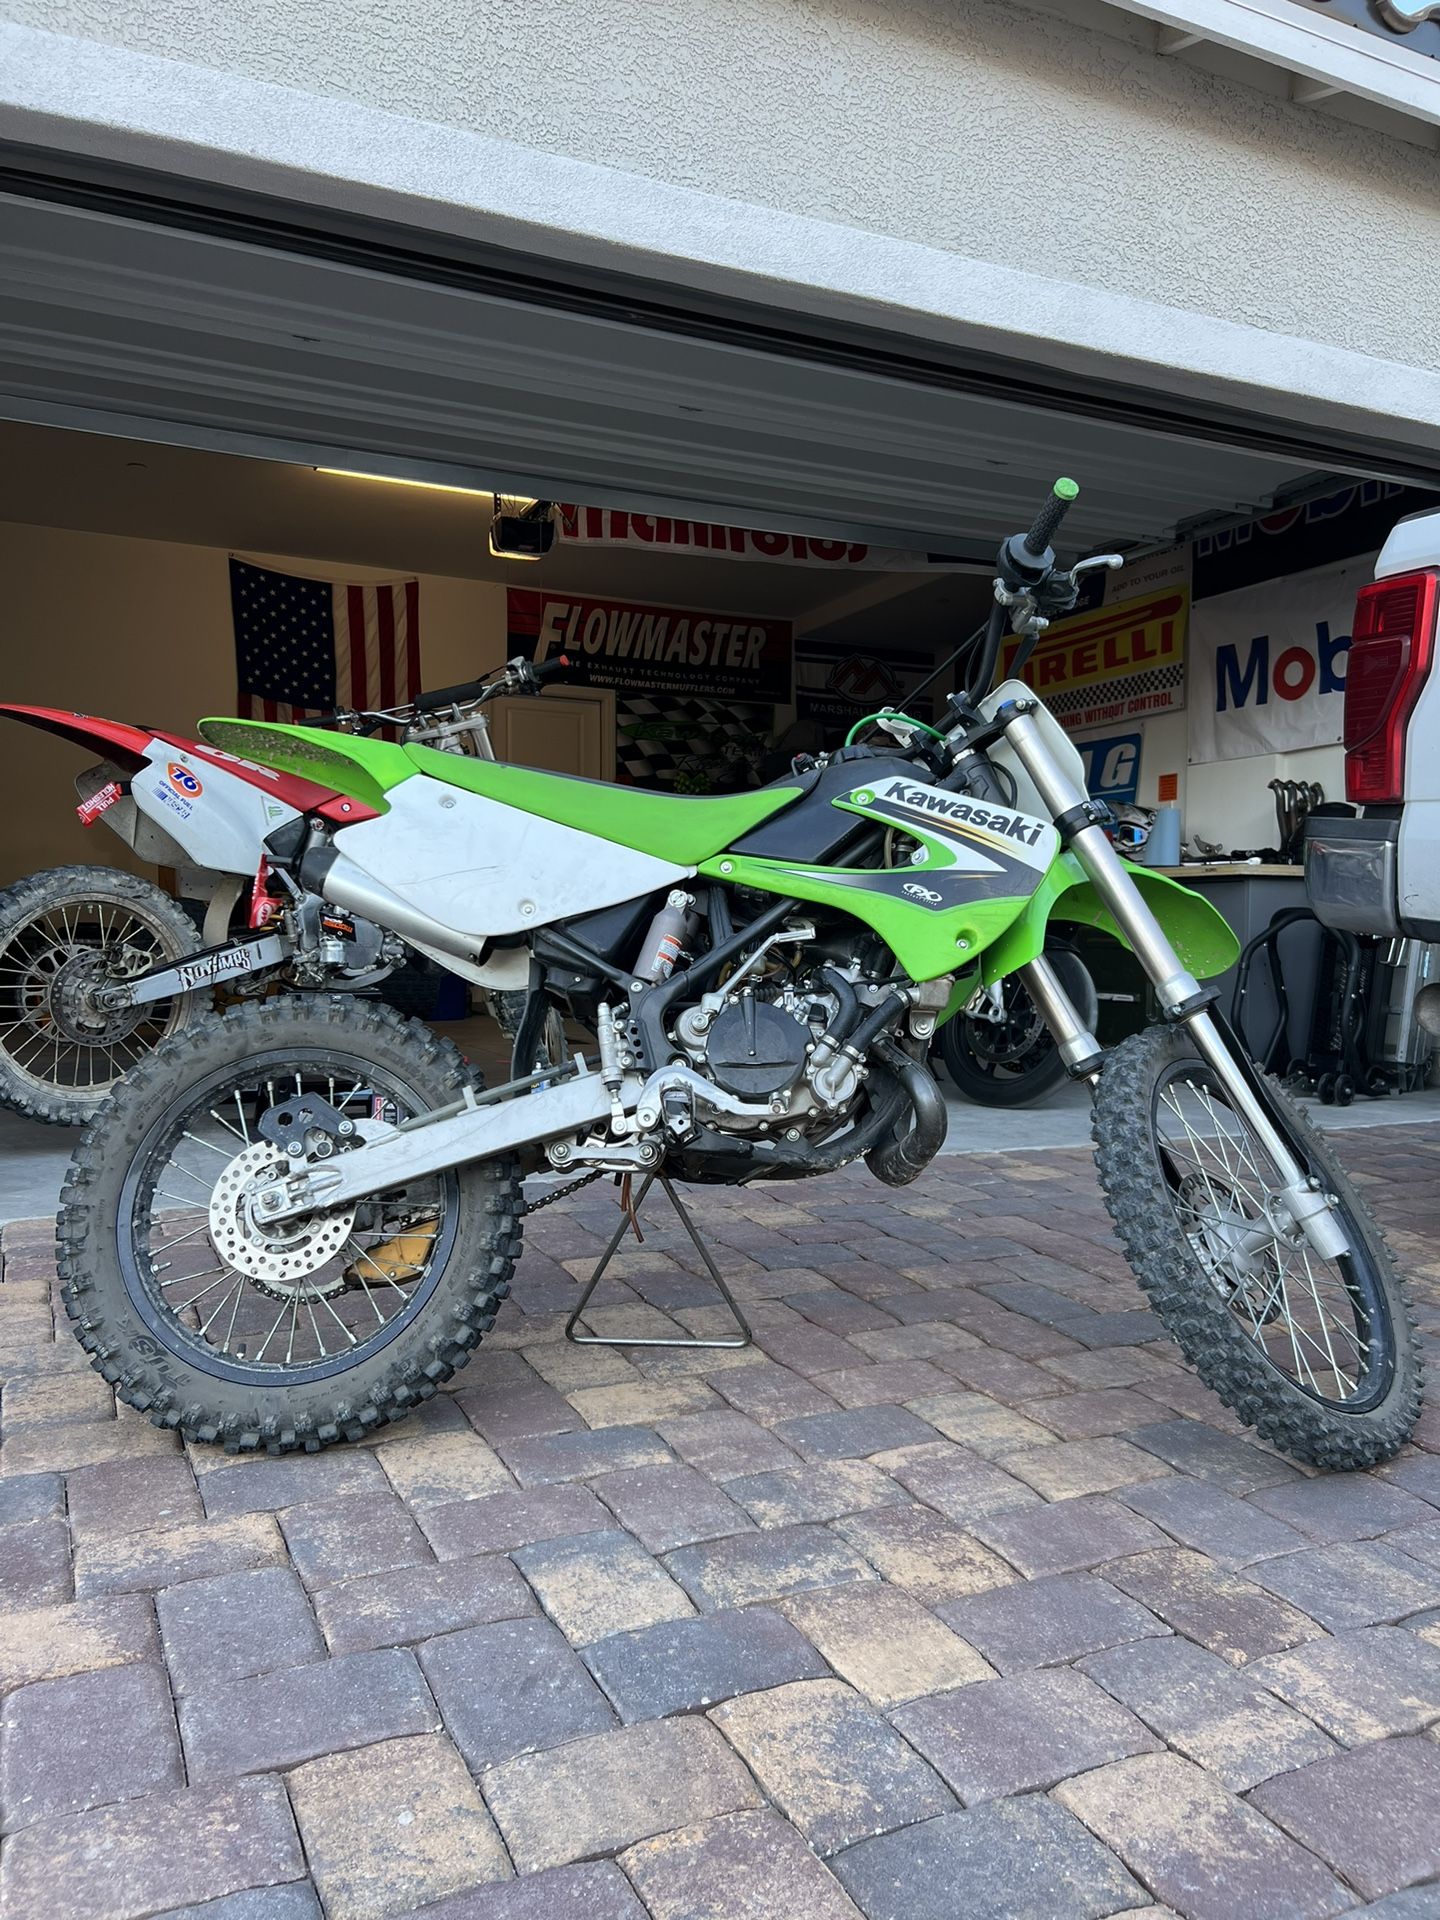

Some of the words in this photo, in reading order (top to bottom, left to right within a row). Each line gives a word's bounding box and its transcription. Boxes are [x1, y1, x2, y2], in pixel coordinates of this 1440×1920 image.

[1130, 578, 1141, 587] TO
[1143, 569, 1169, 582] YOUR
[1170, 564, 1184, 575] OIL
[533, 601, 768, 671] FLOWMASTER
[587, 661, 635, 674] EXHAUST
[640, 668, 711, 680] TECHNOLOGY
[715, 674, 761, 685] COMPANY
[589, 673, 736, 695] WWW.FLOWMASTERMUFFLERS.COM
[1084, 702, 1126, 723] WITHOUT
[1127, 691, 1174, 713] CONTROL
[171, 766, 199, 791] 76
[81, 783, 116, 812] HOLESHOT
[97, 796, 115, 812] PULL
[158, 780, 181, 800] OFFICIAL
[180, 798, 193, 811] FUEL
[883, 781, 1045, 847] Kawasaki
[116, 1318, 191, 1389] TUSK
